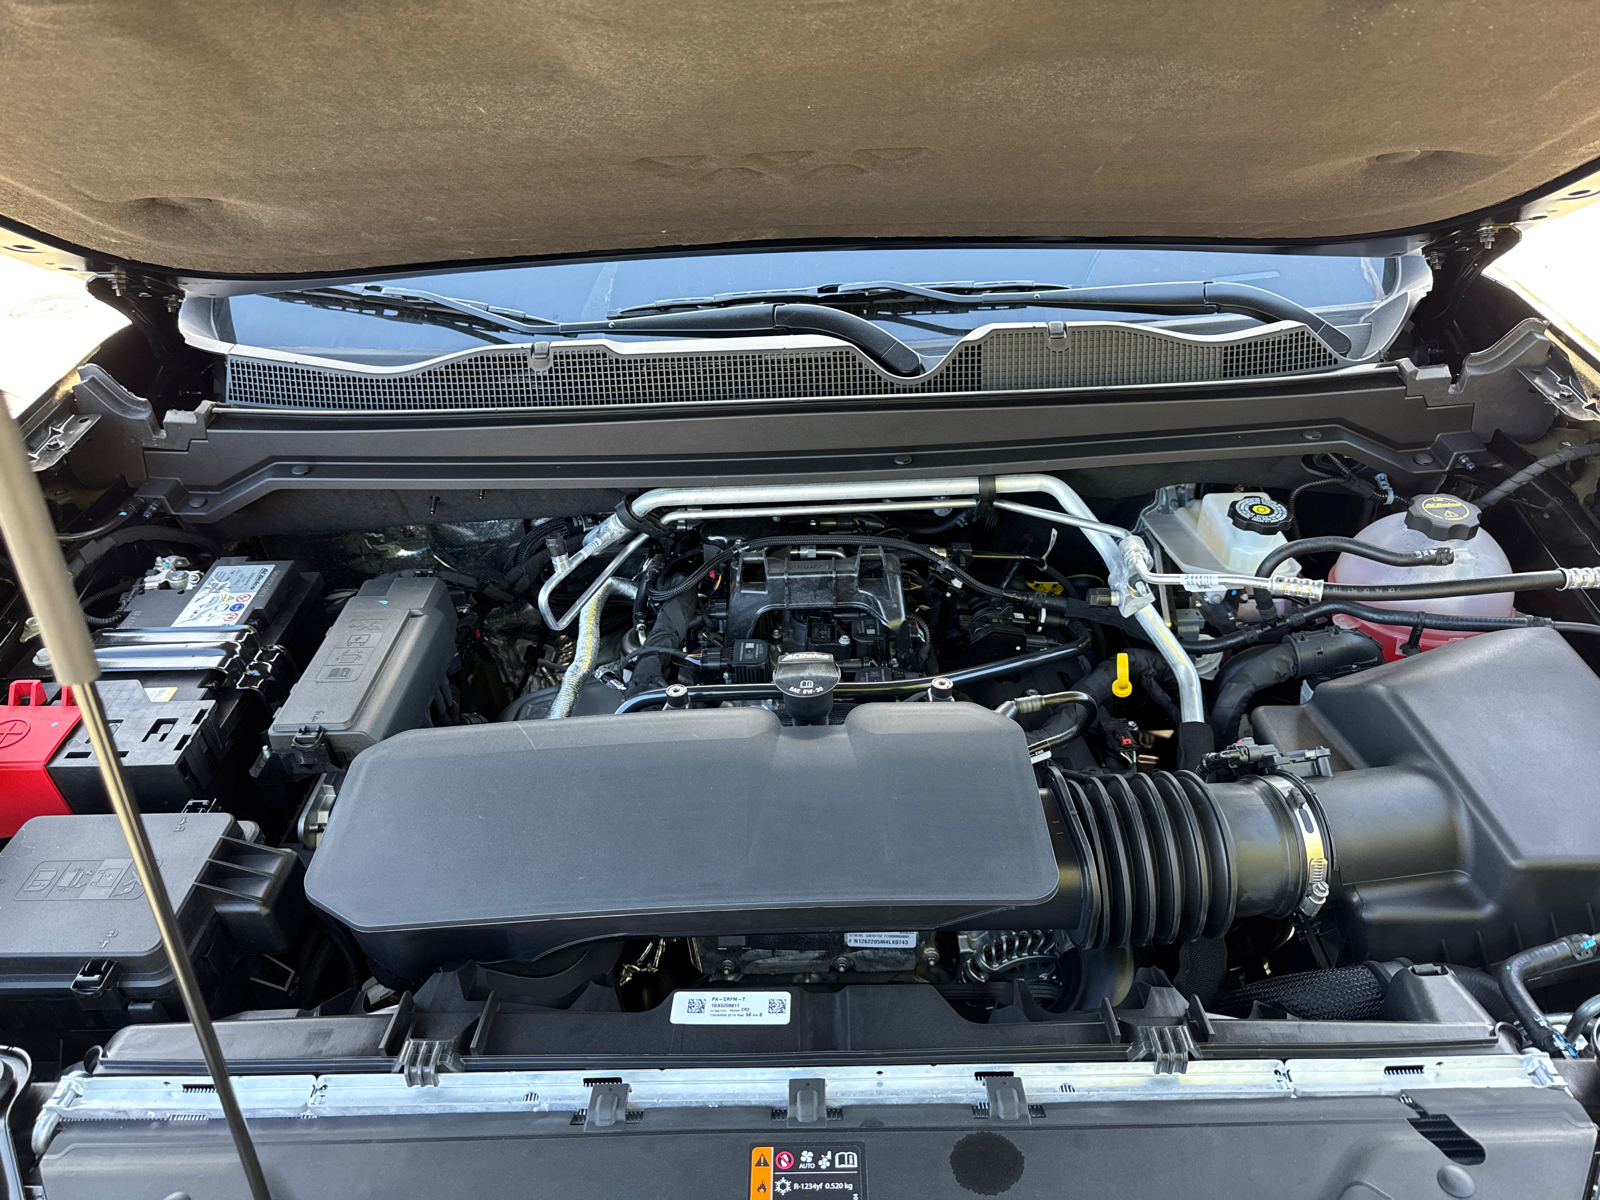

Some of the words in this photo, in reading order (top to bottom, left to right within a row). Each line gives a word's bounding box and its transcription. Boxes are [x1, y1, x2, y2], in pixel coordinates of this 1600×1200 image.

[782, 653, 830, 661] ACDelco
[789, 686, 801, 694] SAE
[793, 1181, 823, 1191] R-1234yf
[844, 1181, 853, 1191] kg
